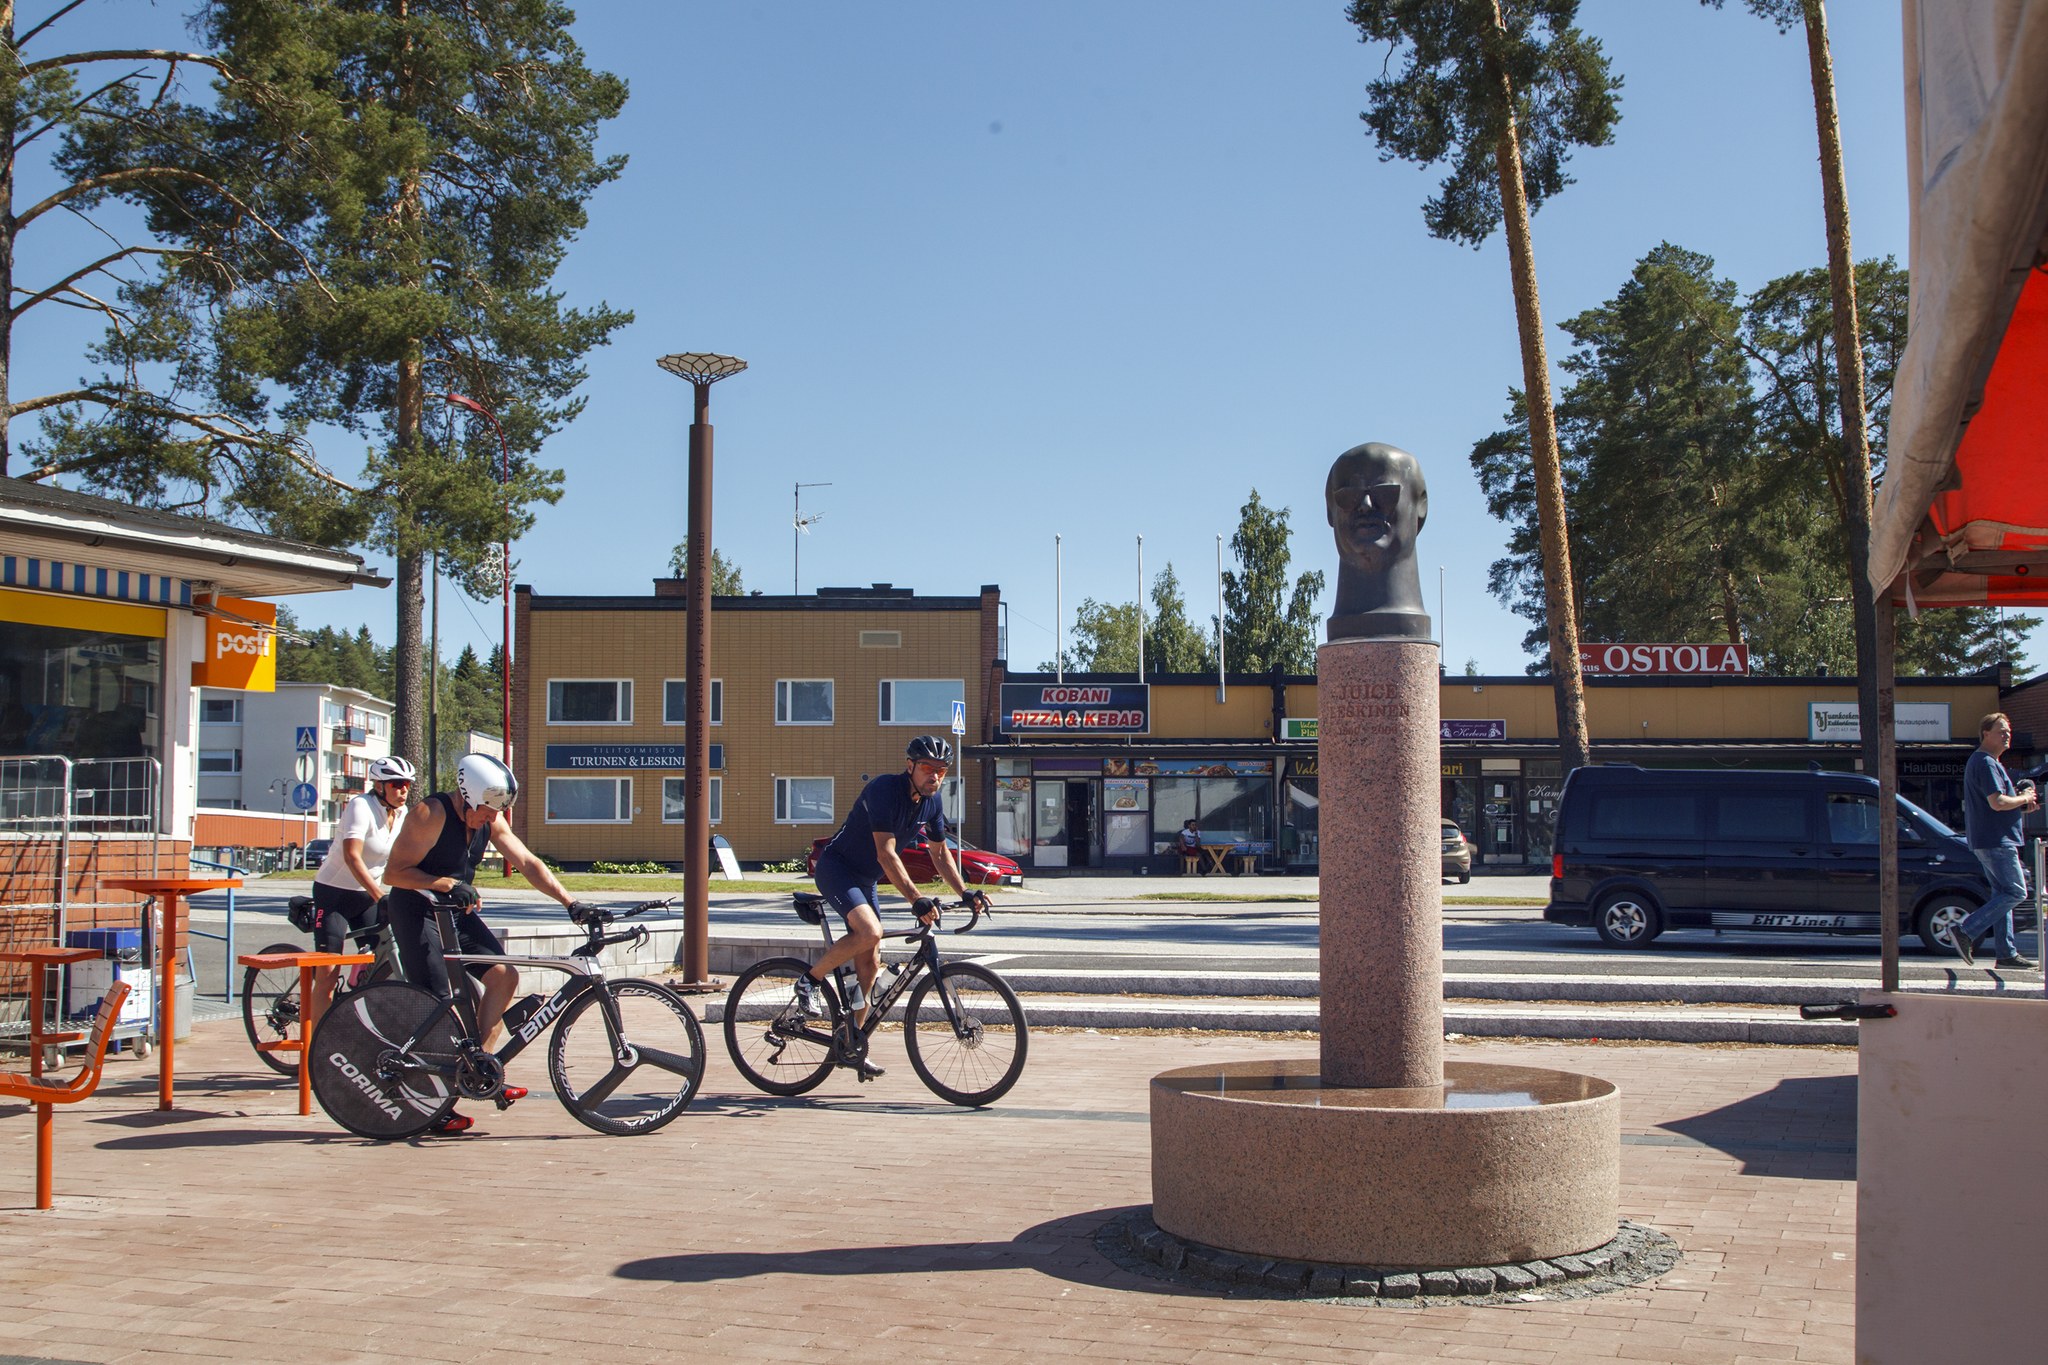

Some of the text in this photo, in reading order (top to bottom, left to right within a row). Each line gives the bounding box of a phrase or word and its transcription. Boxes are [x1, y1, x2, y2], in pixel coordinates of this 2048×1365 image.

[695, 609, 704, 635] eikä
[217, 631, 269, 659] posti
[1603, 645, 1743, 672] OSTOLA
[694, 674, 705, 714] pellon
[1041, 688, 1111, 704] KOBANI
[1338, 683, 1398, 700] JUICE
[1012, 710, 1144, 727] PIZZA & KEBAB
[1329, 704, 1410, 719] LESKINEN
[693, 720, 703, 759] lentää
[570, 756, 627, 766] TURUNEN
[629, 756, 638, 767] &
[458, 768, 470, 800] KASK
[693, 766, 703, 799] Varis
[1752, 914, 1846, 927] EHT-Line.fi
[874, 957, 919, 1017] TREK
[520, 990, 568, 1043] BMC
[618, 987, 687, 1027] CORIMA
[400, 1036, 416, 1055] BMC
[558, 1024, 578, 1100] CORIMA
[329, 1052, 403, 1120] CORIMA
[623, 1079, 691, 1127] CORIMA
